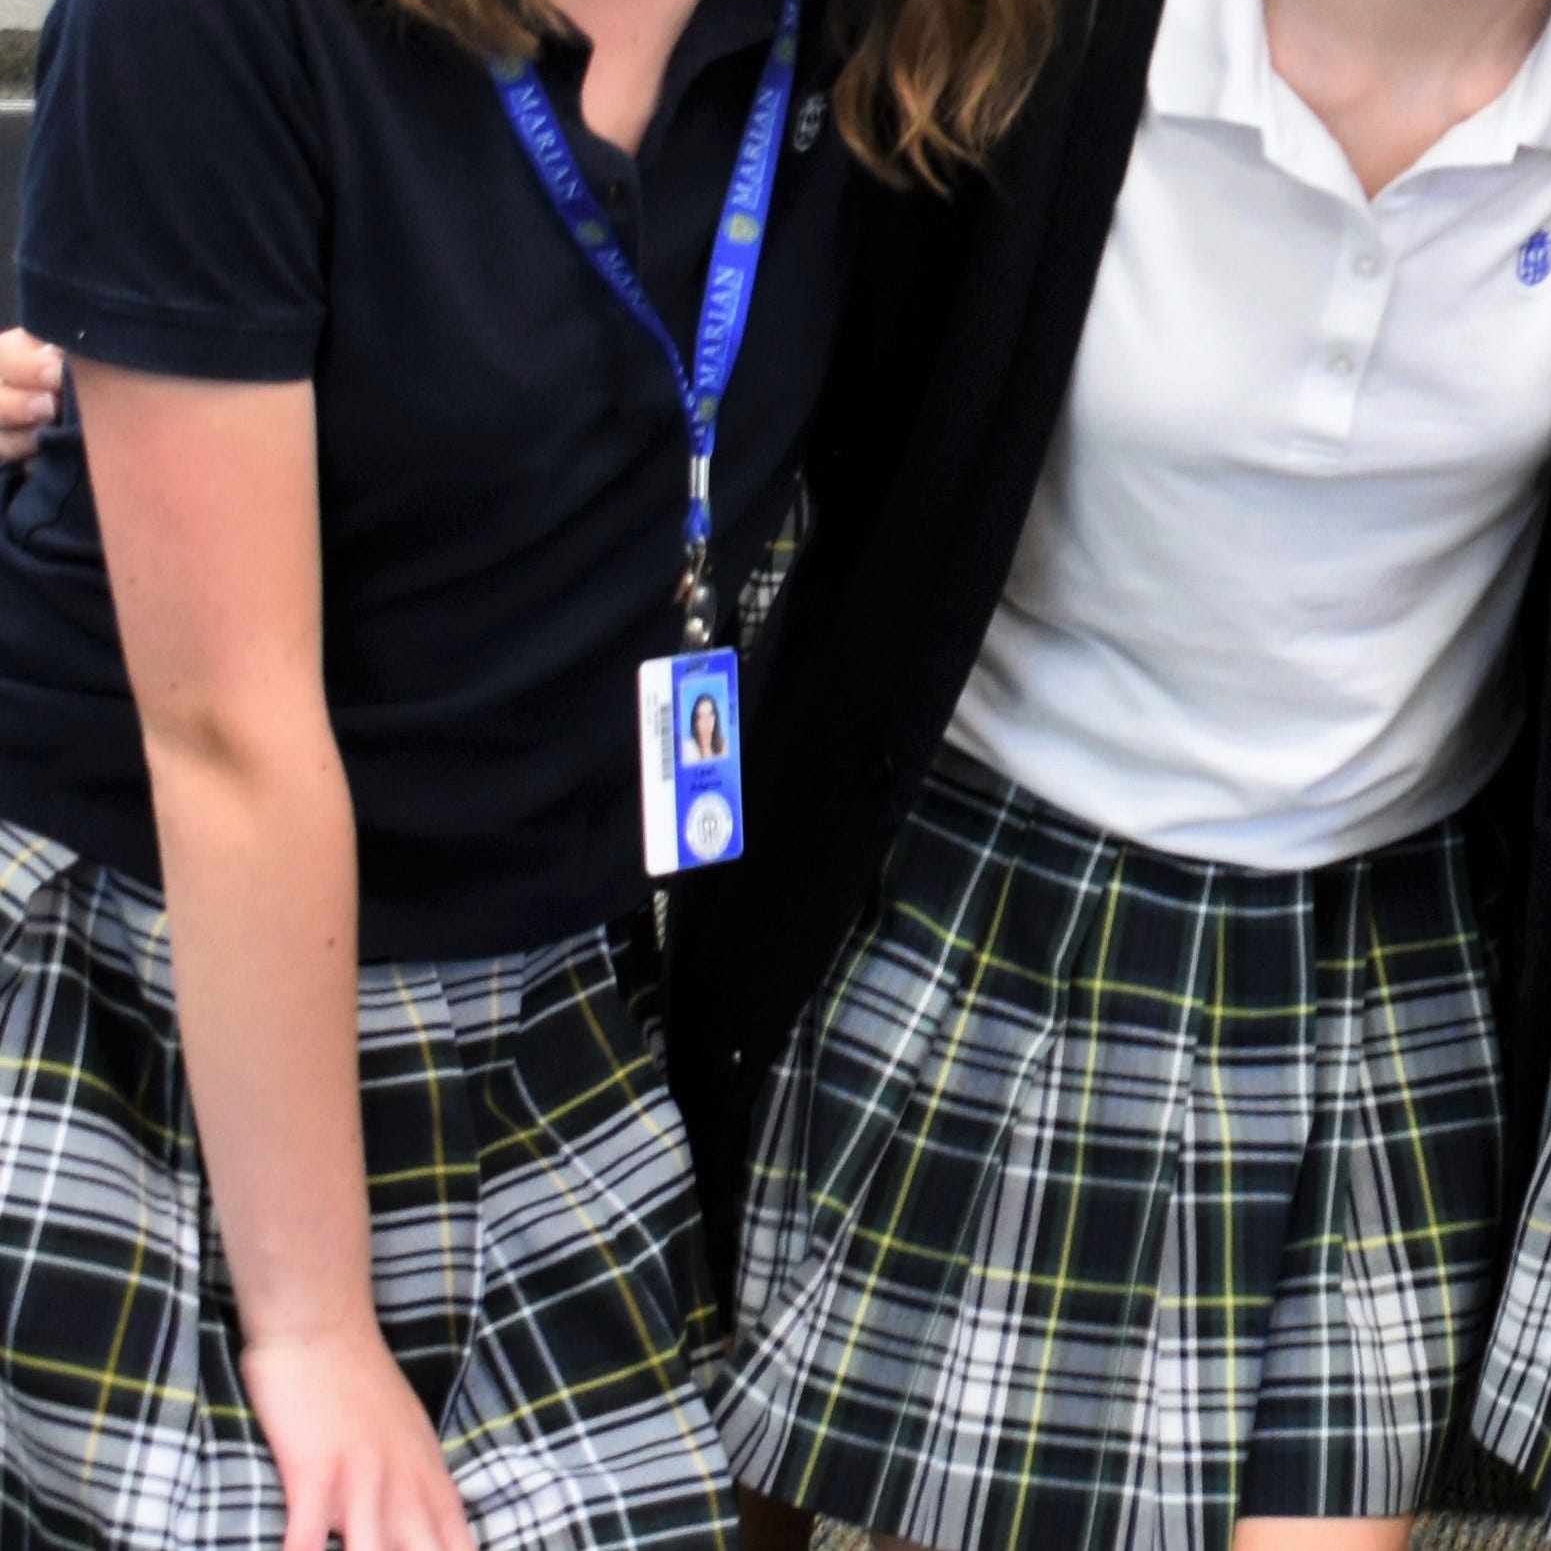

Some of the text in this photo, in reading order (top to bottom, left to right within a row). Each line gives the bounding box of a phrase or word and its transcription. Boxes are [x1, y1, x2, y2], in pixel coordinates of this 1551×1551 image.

[518, 83, 584, 202] MARIAN
[730, 86, 775, 209] MARIAN
[699, 264, 738, 389] MARIAN
